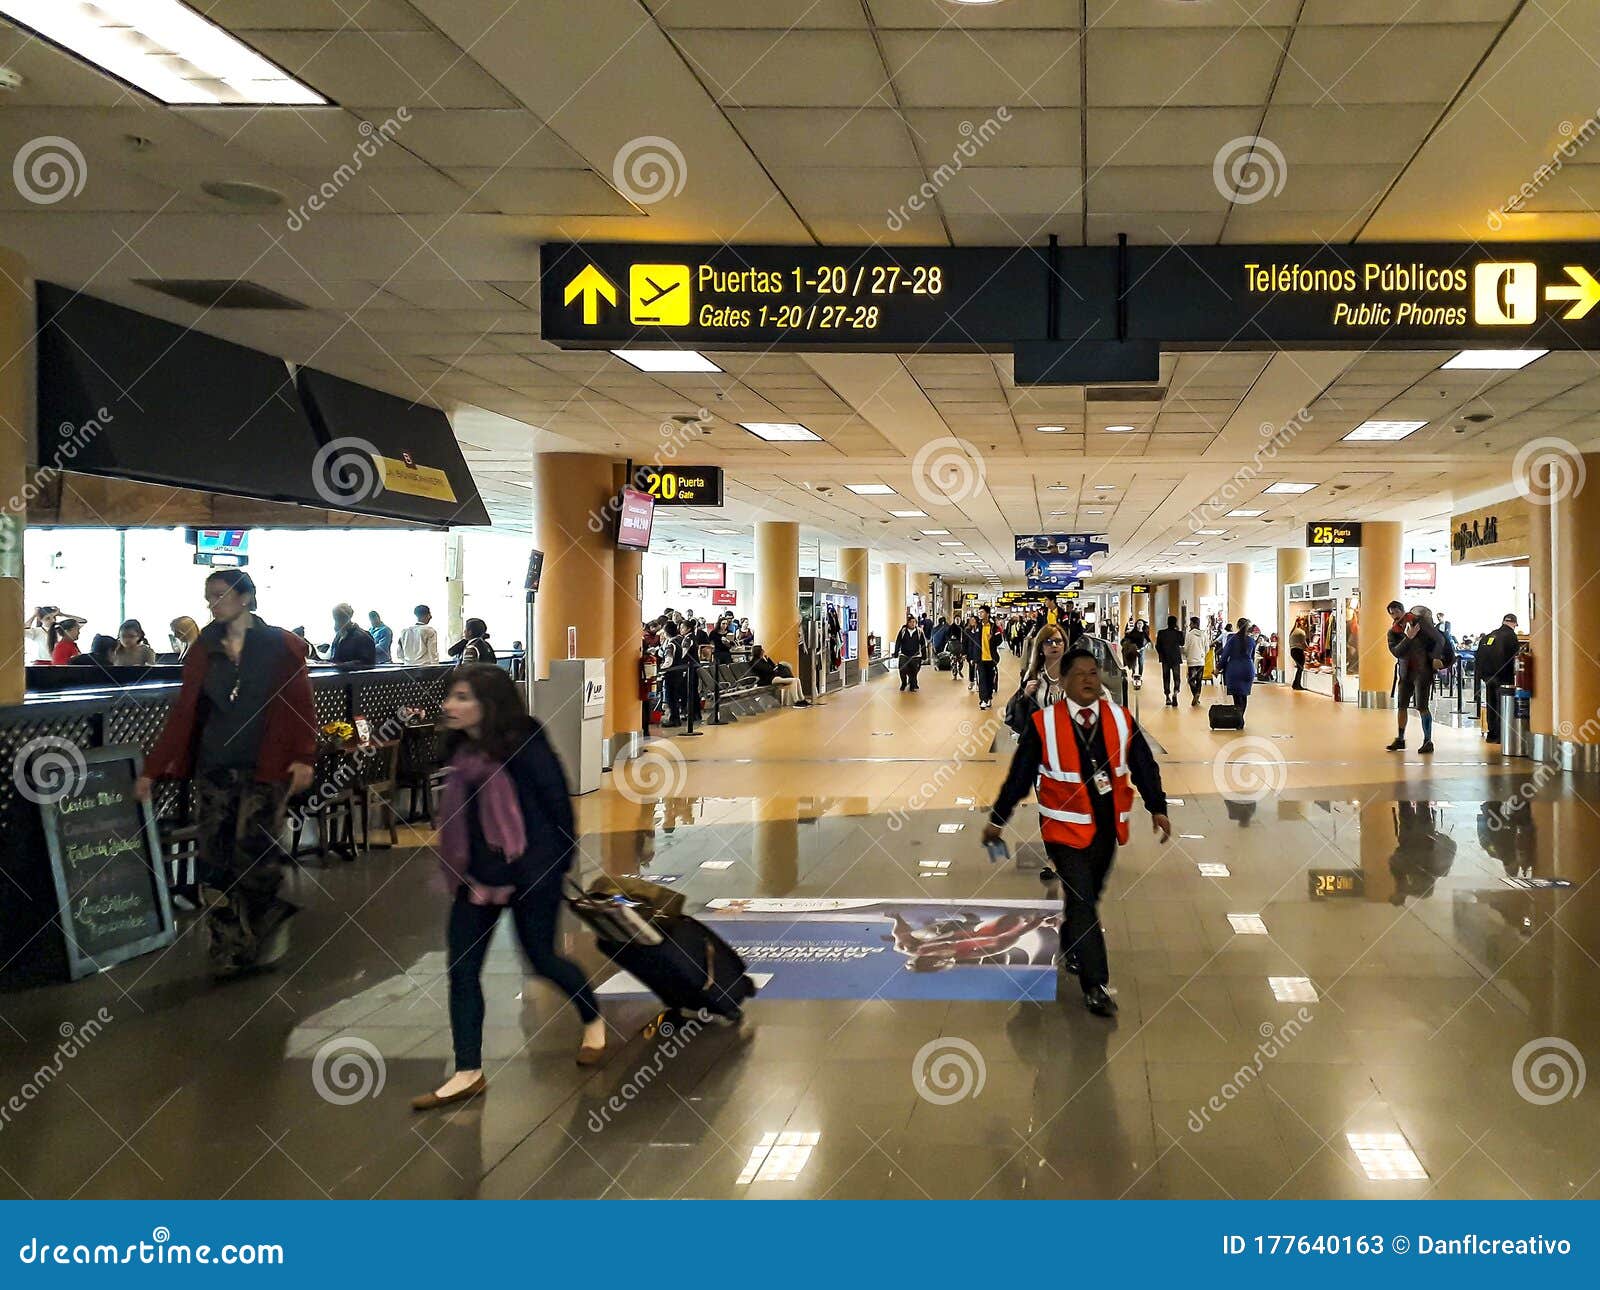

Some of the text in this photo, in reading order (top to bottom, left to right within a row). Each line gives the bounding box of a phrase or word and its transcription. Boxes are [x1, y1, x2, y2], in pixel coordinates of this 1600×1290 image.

[698, 265, 943, 296] Puertas 1-20 / 27-28
[1244, 263, 1468, 292] Teléfonos Públicos
[699, 304, 879, 330] Gates 1-20 / 27-28
[1334, 303, 1467, 325] Public Phones
[647, 473, 704, 499] 20 Puerta
[1313, 526, 1334, 544] 25
